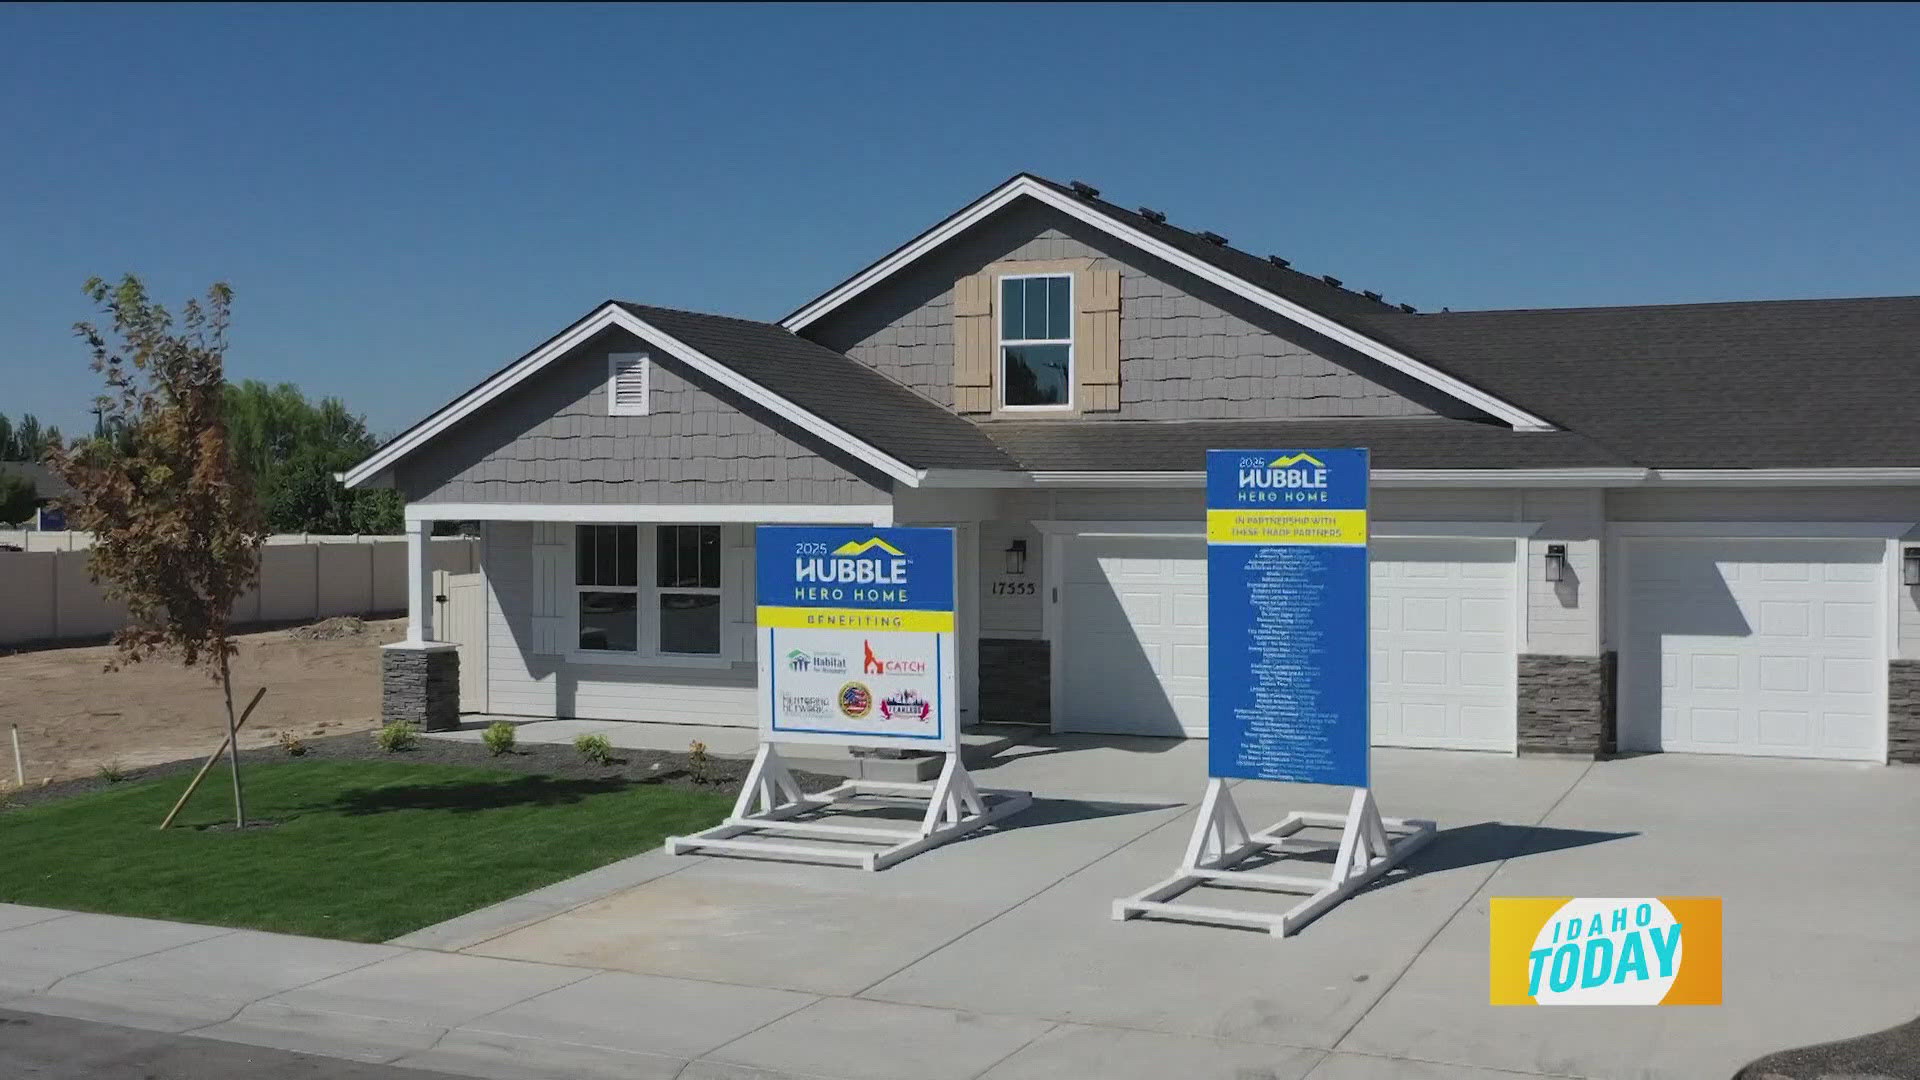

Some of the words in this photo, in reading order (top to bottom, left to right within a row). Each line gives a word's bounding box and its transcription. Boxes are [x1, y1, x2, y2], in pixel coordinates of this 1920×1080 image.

[1239, 469, 1328, 488] HUBBLE
[1238, 491, 1277, 502] HERO
[1285, 491, 1329, 502] HOME
[1235, 516, 1245, 524] IN
[1247, 516, 1310, 525] PARTNERSHIP
[1311, 517, 1337, 525] WITH
[1232, 527, 1258, 536] THESE
[1262, 528, 1291, 536] TRADE
[1293, 528, 1342, 538] PARTNERS
[796, 542, 828, 555] 2025
[796, 557, 908, 584] HUBBLE
[795, 587, 844, 601] HERO
[854, 588, 909, 602] HOME
[807, 614, 902, 627] BENEFITING
[813, 656, 847, 669] Habitat
[886, 661, 925, 672] CATCH
